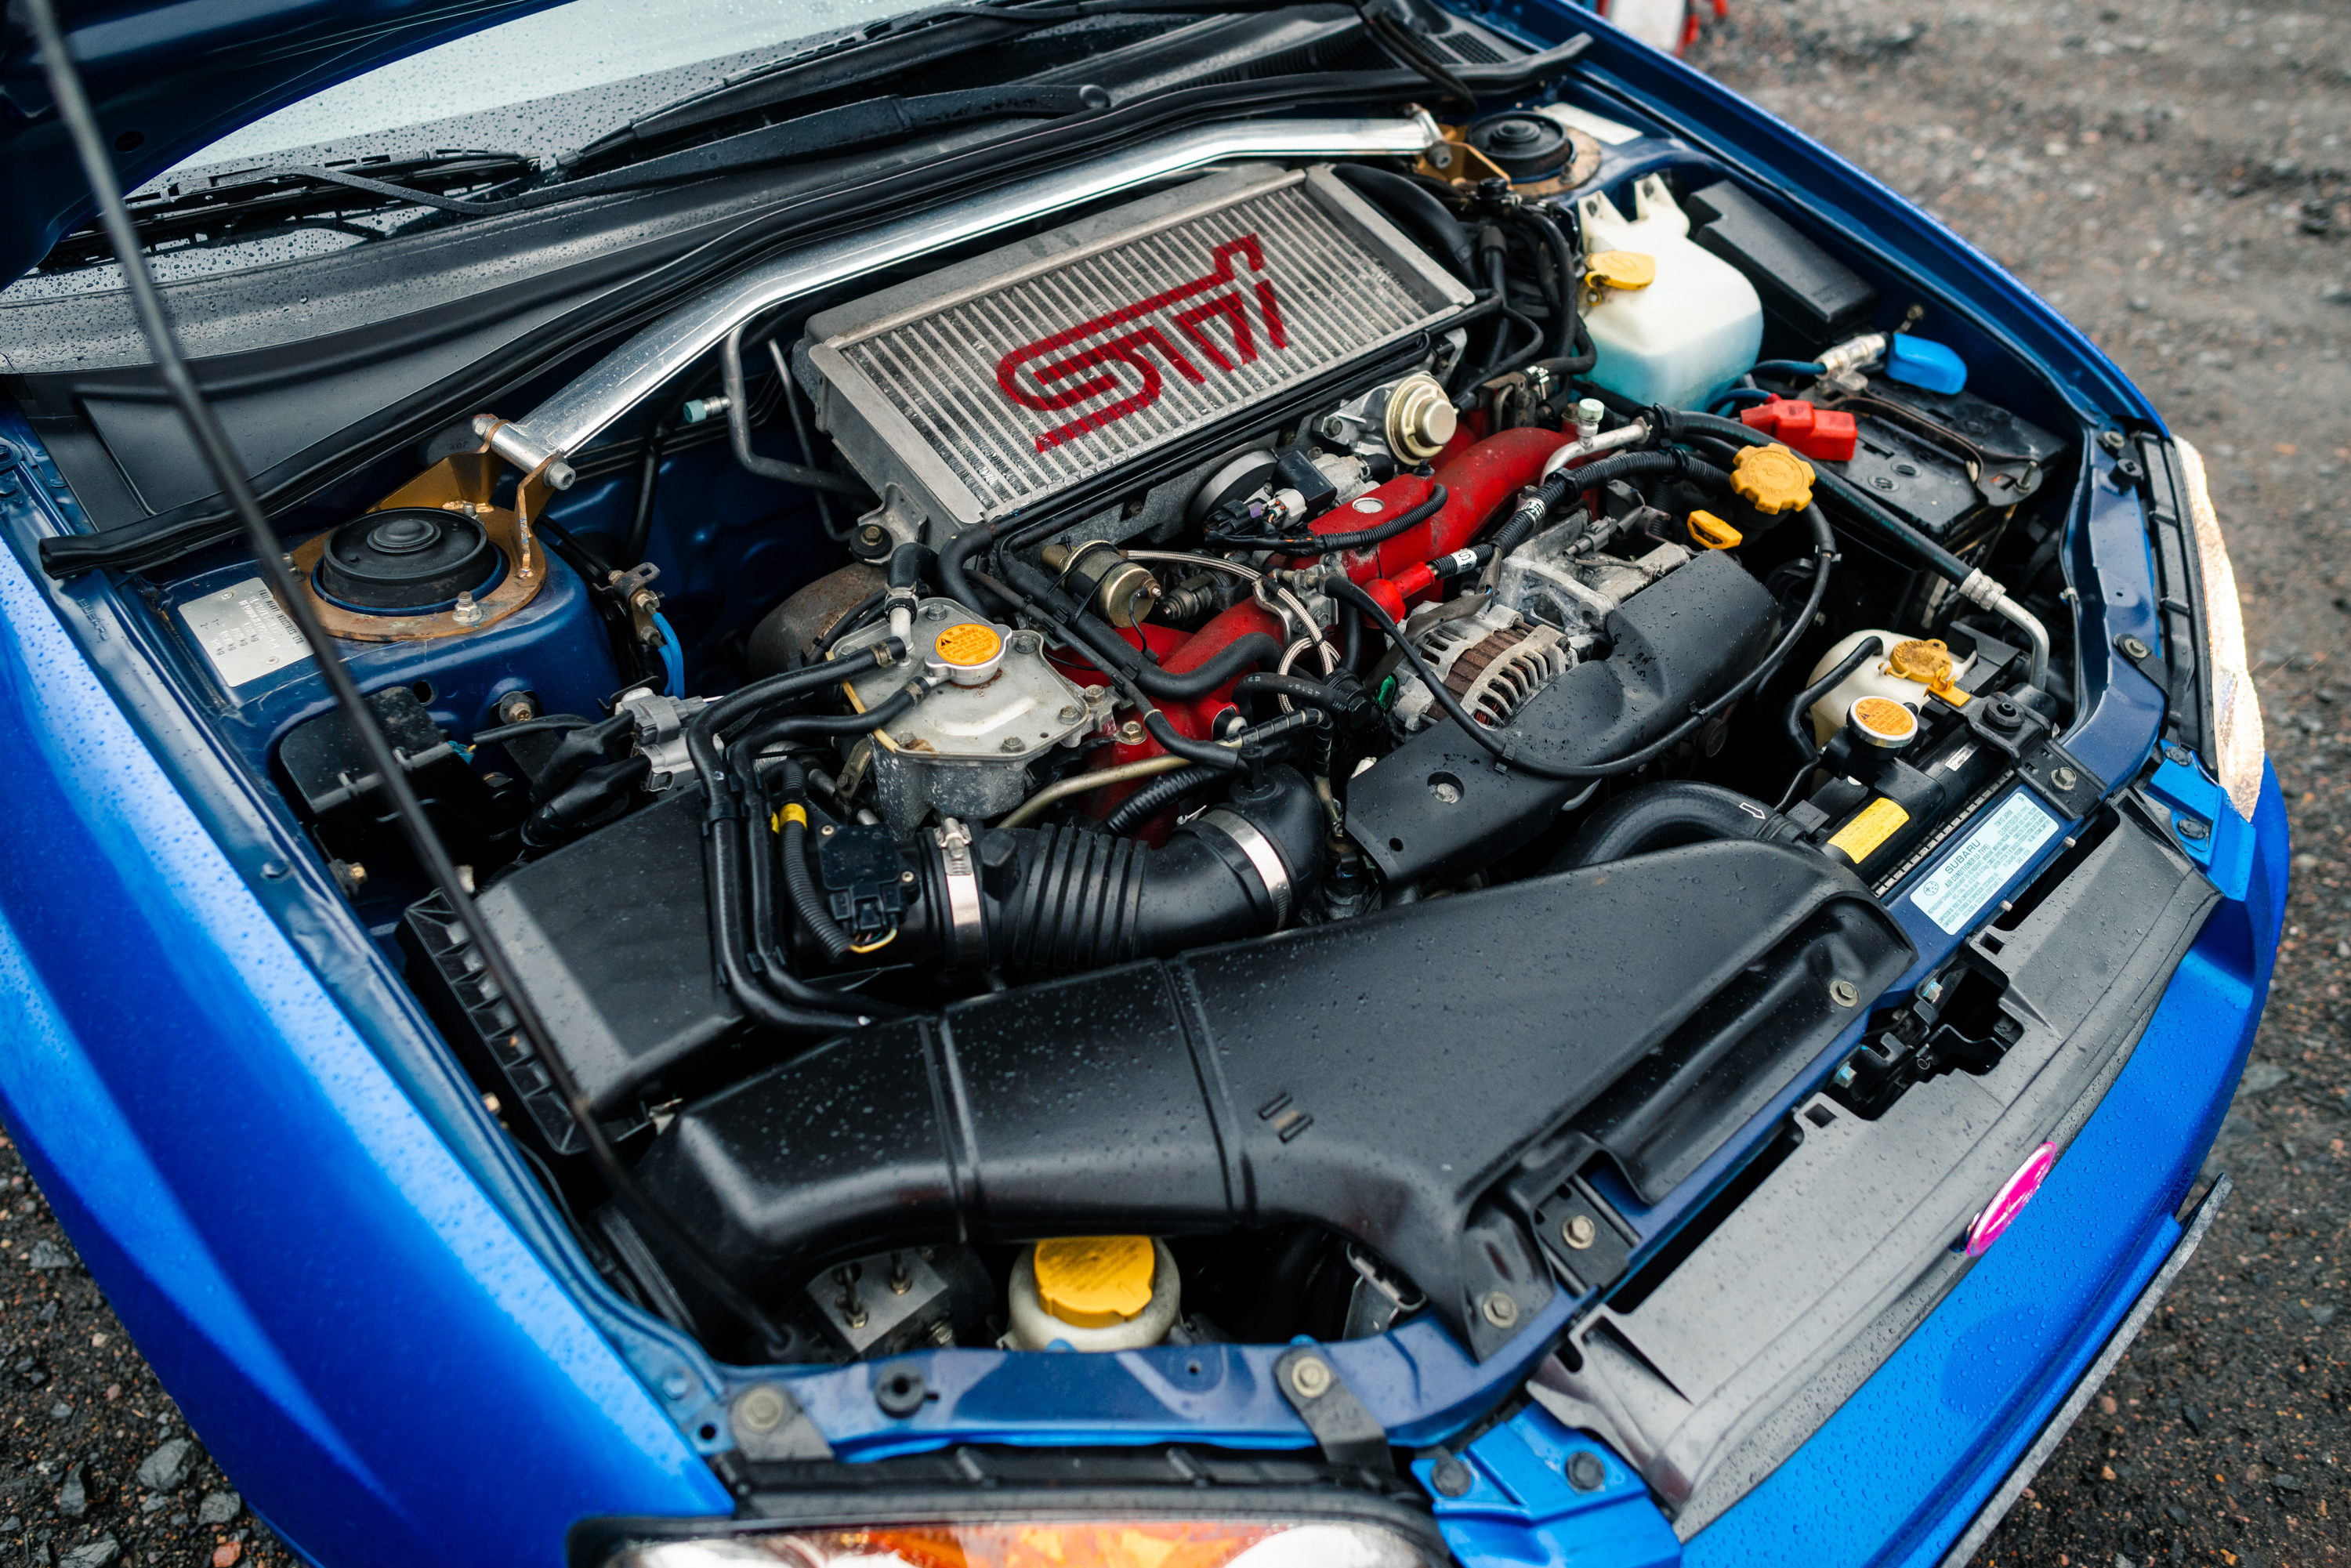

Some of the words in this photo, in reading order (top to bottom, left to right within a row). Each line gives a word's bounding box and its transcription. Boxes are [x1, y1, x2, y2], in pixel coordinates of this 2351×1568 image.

[276, 613, 297, 635] INDUSTRIES
[950, 627, 979, 640] WARNING
[1997, 814, 2020, 836] CLIMATISEUR
[2001, 809, 2013, 819] JAPAN
[1943, 838, 1981, 875] SUBARU
[1943, 878, 1954, 888] AIR
[1950, 856, 1976, 882] CONDITIONER
